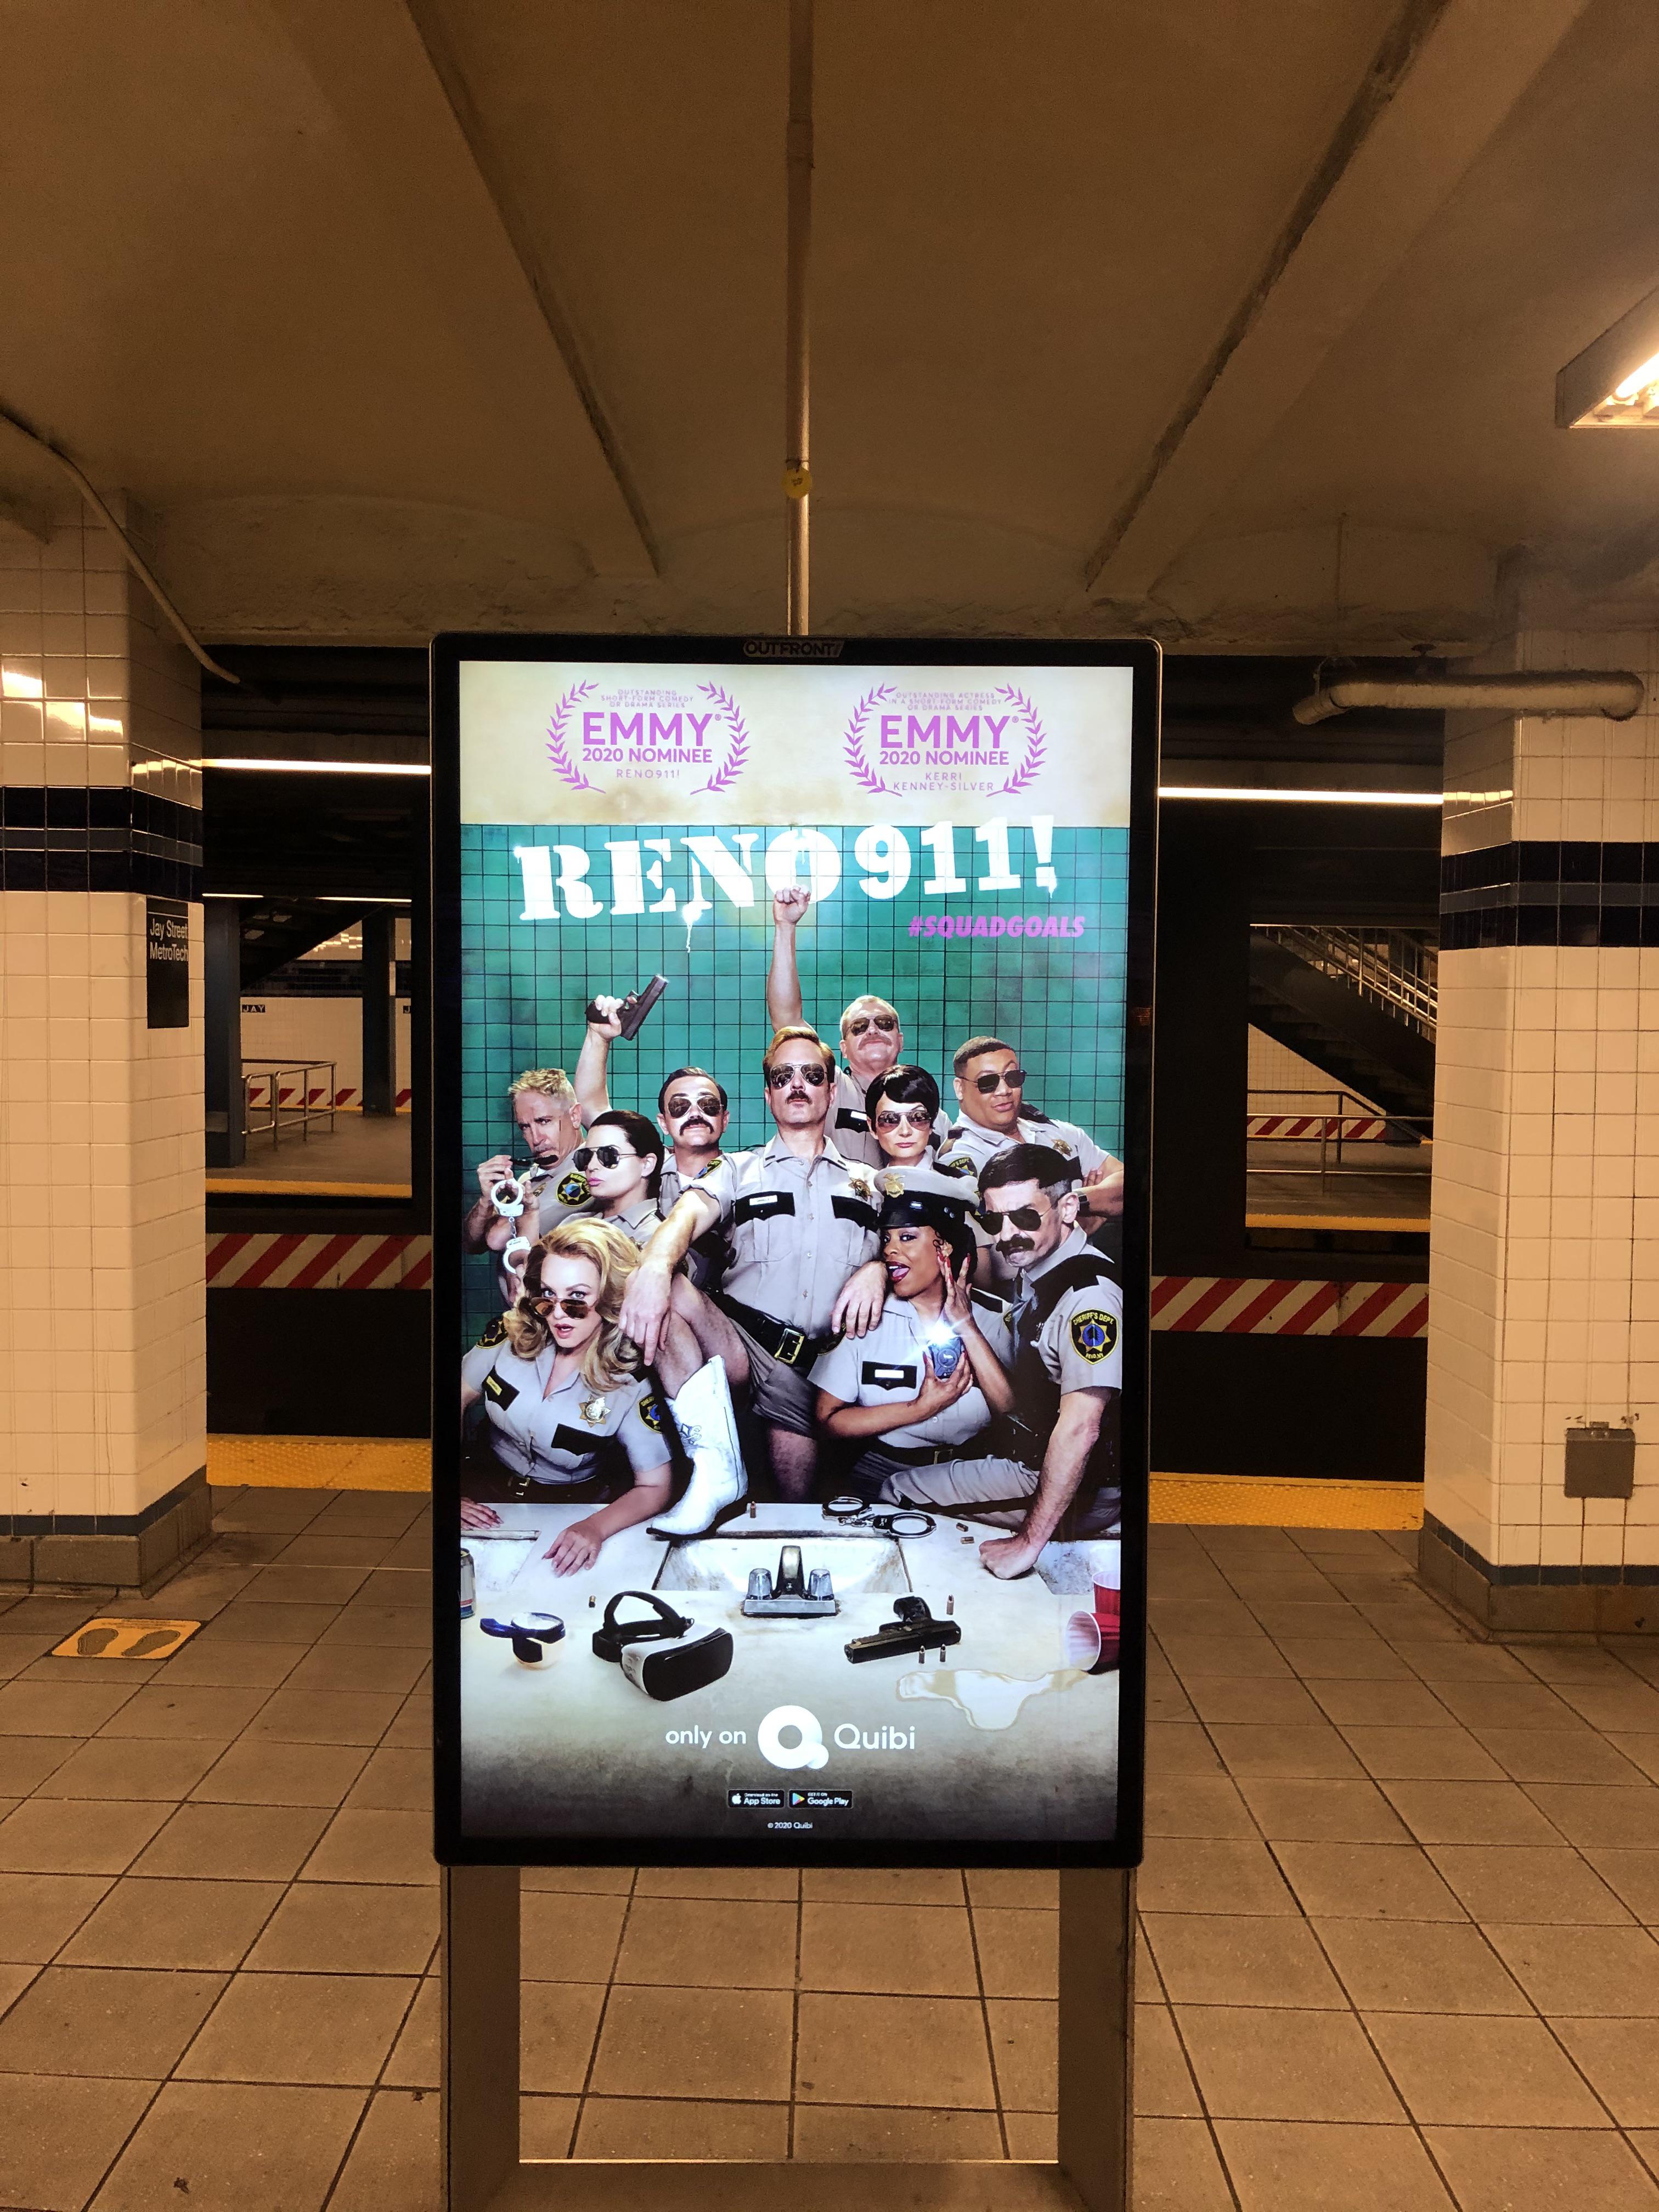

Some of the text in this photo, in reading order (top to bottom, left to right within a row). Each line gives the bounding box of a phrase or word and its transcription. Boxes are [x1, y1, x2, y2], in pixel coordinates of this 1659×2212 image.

[582, 747, 713, 763] 2020 NOMINEE
[879, 751, 1009, 765] 2020 NOMINEE
[616, 769, 680, 779] RENO911!
[926, 772, 962, 781] KERRI
[893, 782, 994, 791] KENNEY-SILVER
[150, 918, 188, 941] Jay Street
[908, 915, 1085, 939] #SQUADGOALS
[150, 941, 189, 961] MetroTech
[665, 1724, 713, 1749] only
[719, 1730, 747, 1744] on
[834, 1723, 915, 1750] Quibi
[743, 1797, 760, 1805] App
[808, 1797, 849, 1806] Google Play
